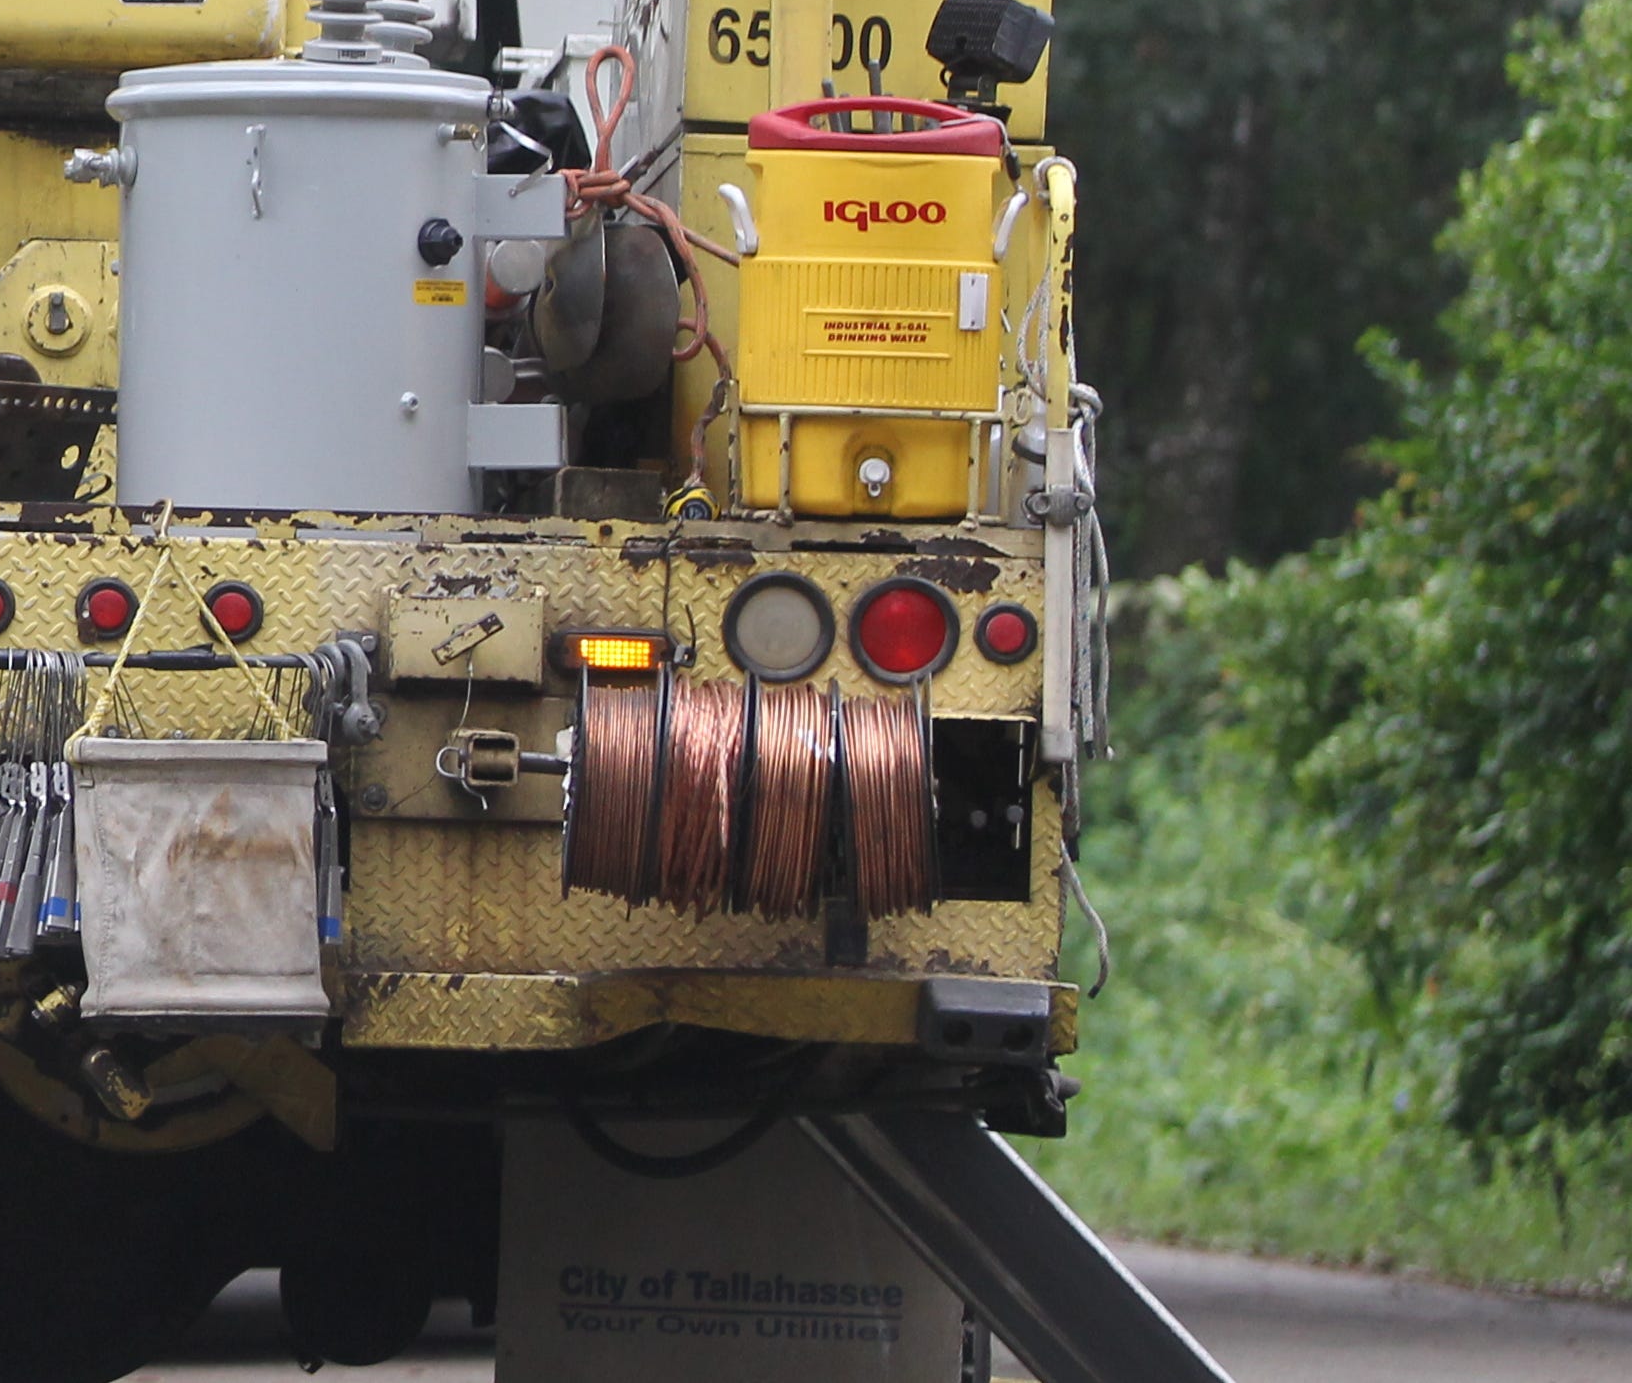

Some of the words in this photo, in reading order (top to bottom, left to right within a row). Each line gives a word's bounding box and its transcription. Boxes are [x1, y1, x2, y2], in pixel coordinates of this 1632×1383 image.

[709, 7, 892, 73] 6500
[824, 200, 946, 232] IGLOO
[824, 321, 891, 331] INDUSTRIAL
[896, 322, 931, 331] 5-GAL.
[828, 333, 886, 342] DRINKING
[891, 334, 927, 343] WATER
[560, 1266, 627, 1303] City
[640, 1269, 678, 1298] of
[687, 1271, 903, 1307] Tallahassee
[561, 1311, 644, 1334] Your
[656, 1314, 740, 1338] Own
[755, 1317, 900, 1343] Utilities
